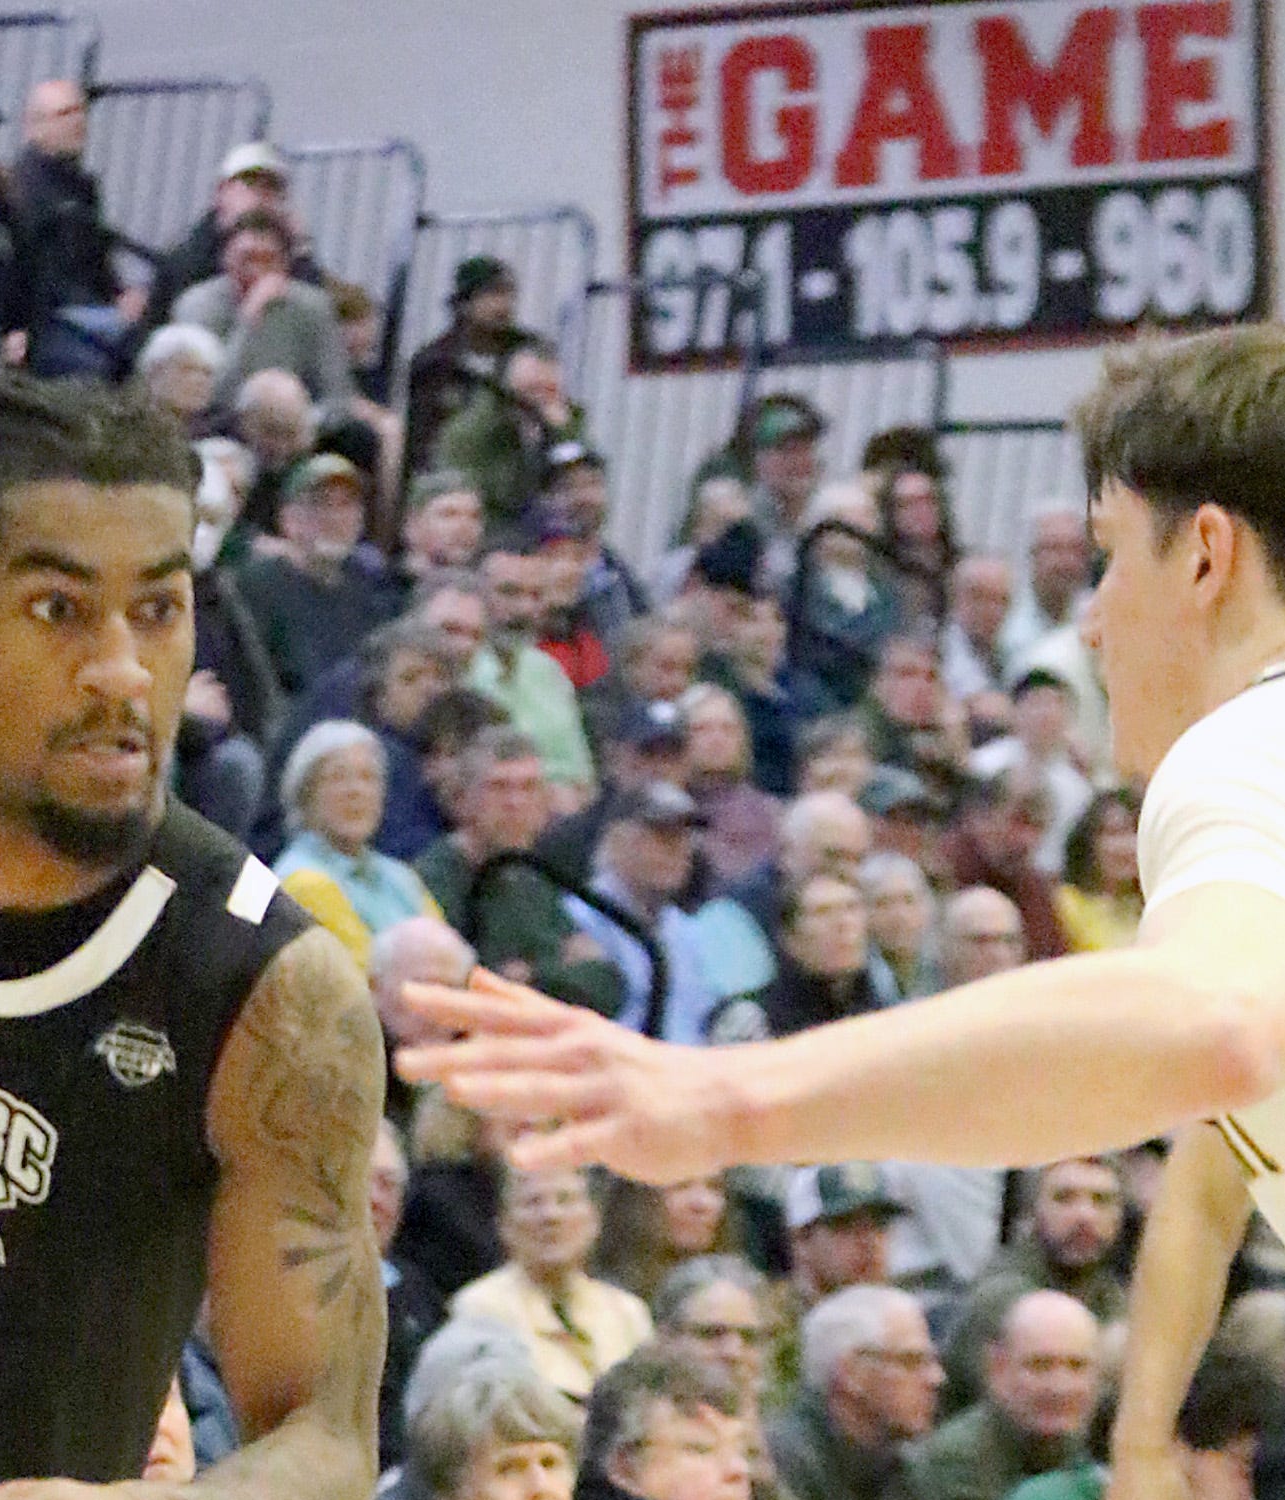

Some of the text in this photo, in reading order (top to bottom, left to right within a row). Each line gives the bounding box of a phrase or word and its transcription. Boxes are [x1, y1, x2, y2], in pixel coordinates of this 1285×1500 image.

[658, 5, 1234, 196] THE GAME
[1092, 186, 1257, 322] 960
